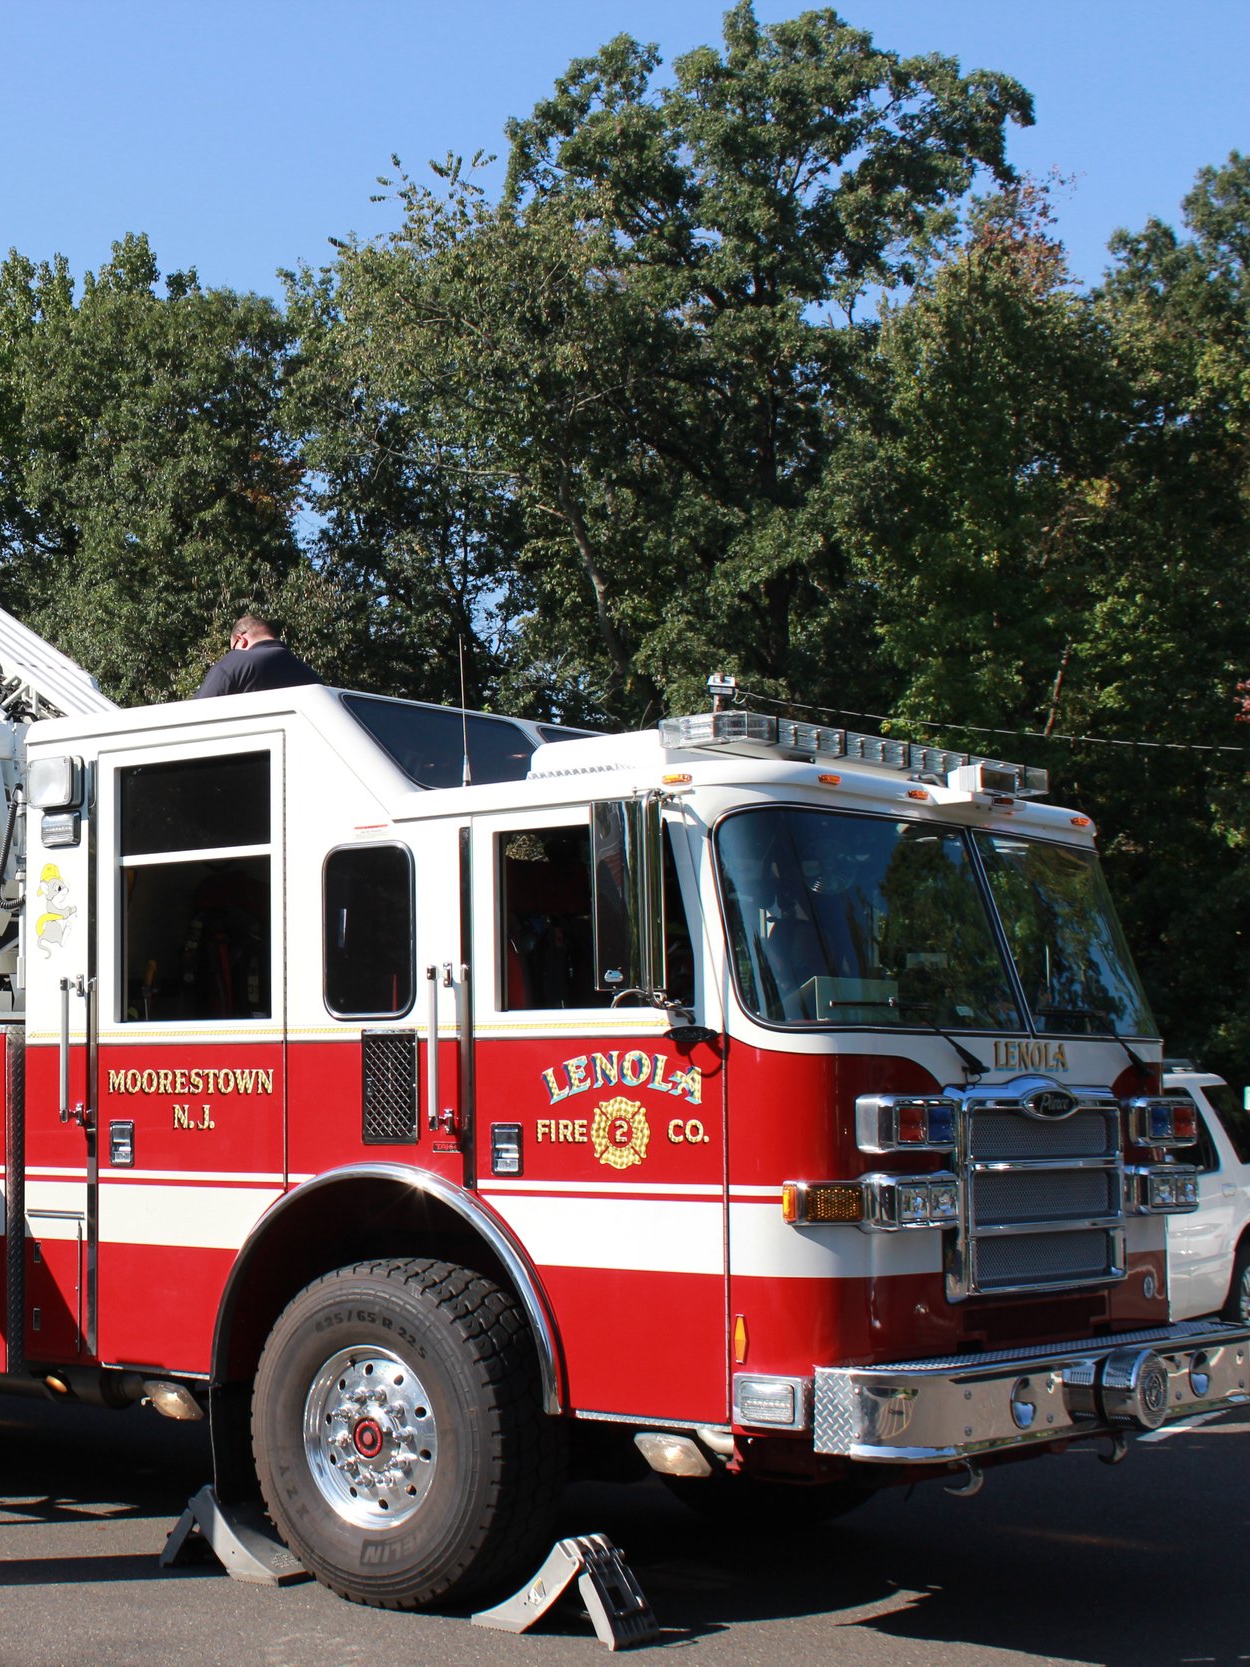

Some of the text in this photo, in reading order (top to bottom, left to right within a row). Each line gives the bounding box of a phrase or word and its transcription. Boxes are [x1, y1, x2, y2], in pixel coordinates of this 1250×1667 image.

[993, 1041, 1069, 1072] LENOLA
[107, 1069, 274, 1096] MOORESTOWN
[541, 1050, 703, 1105] LENOLA
[536, 1119, 710, 1144] FIRE 2 CO.
